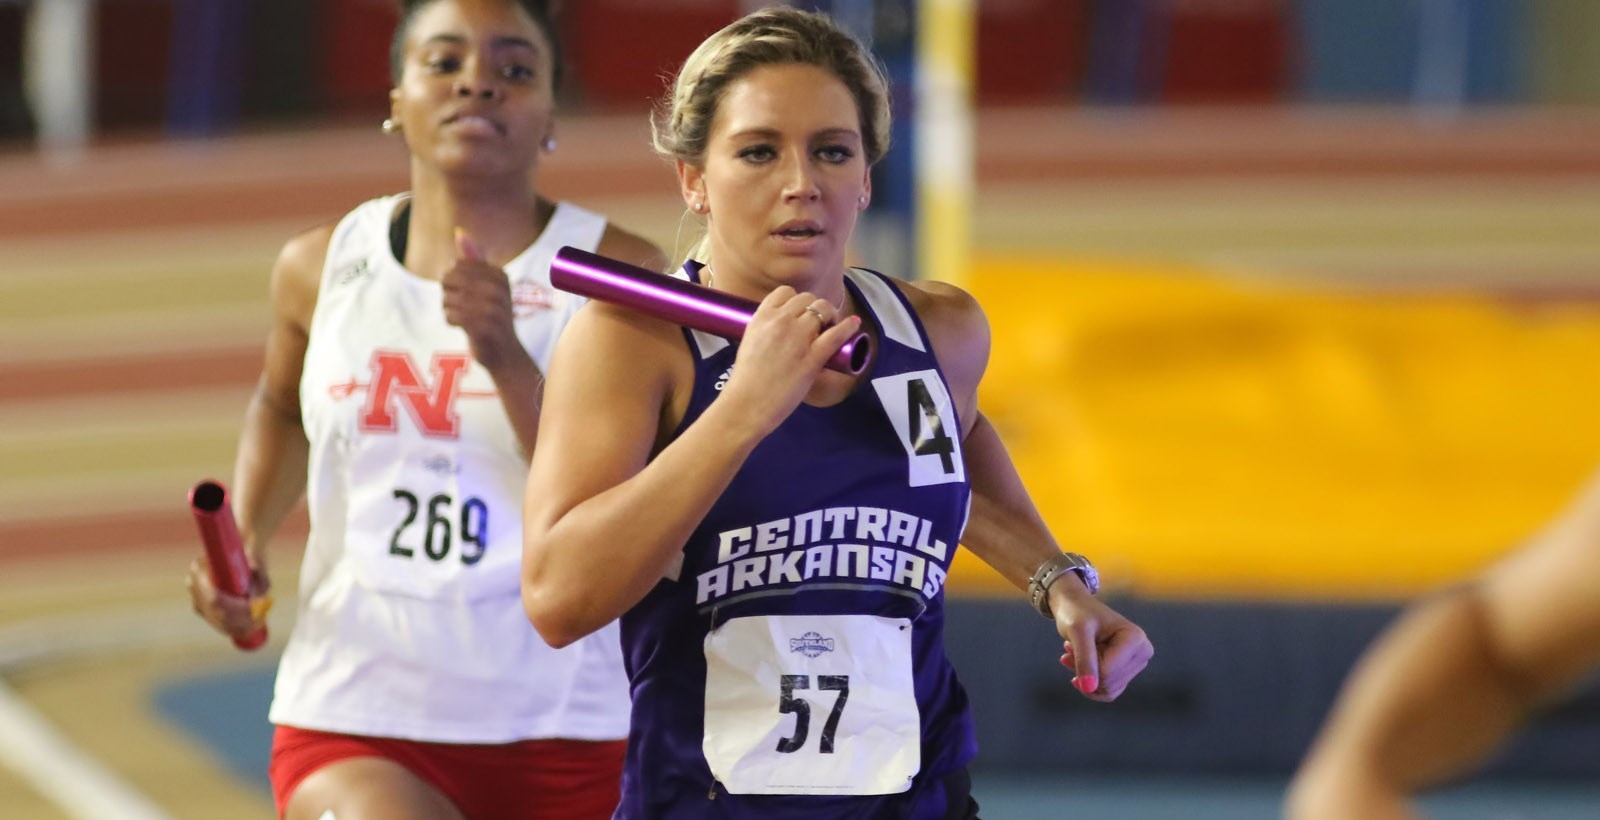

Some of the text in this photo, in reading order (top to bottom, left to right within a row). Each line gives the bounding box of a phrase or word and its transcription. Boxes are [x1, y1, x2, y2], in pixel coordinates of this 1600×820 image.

[358, 348, 471, 440] N
[907, 378, 955, 474] 4
[388, 489, 489, 566] 269
[717, 506, 947, 564] CENTRAL
[696, 544, 947, 600] ARKANSAS
[776, 674, 850, 754] 57
